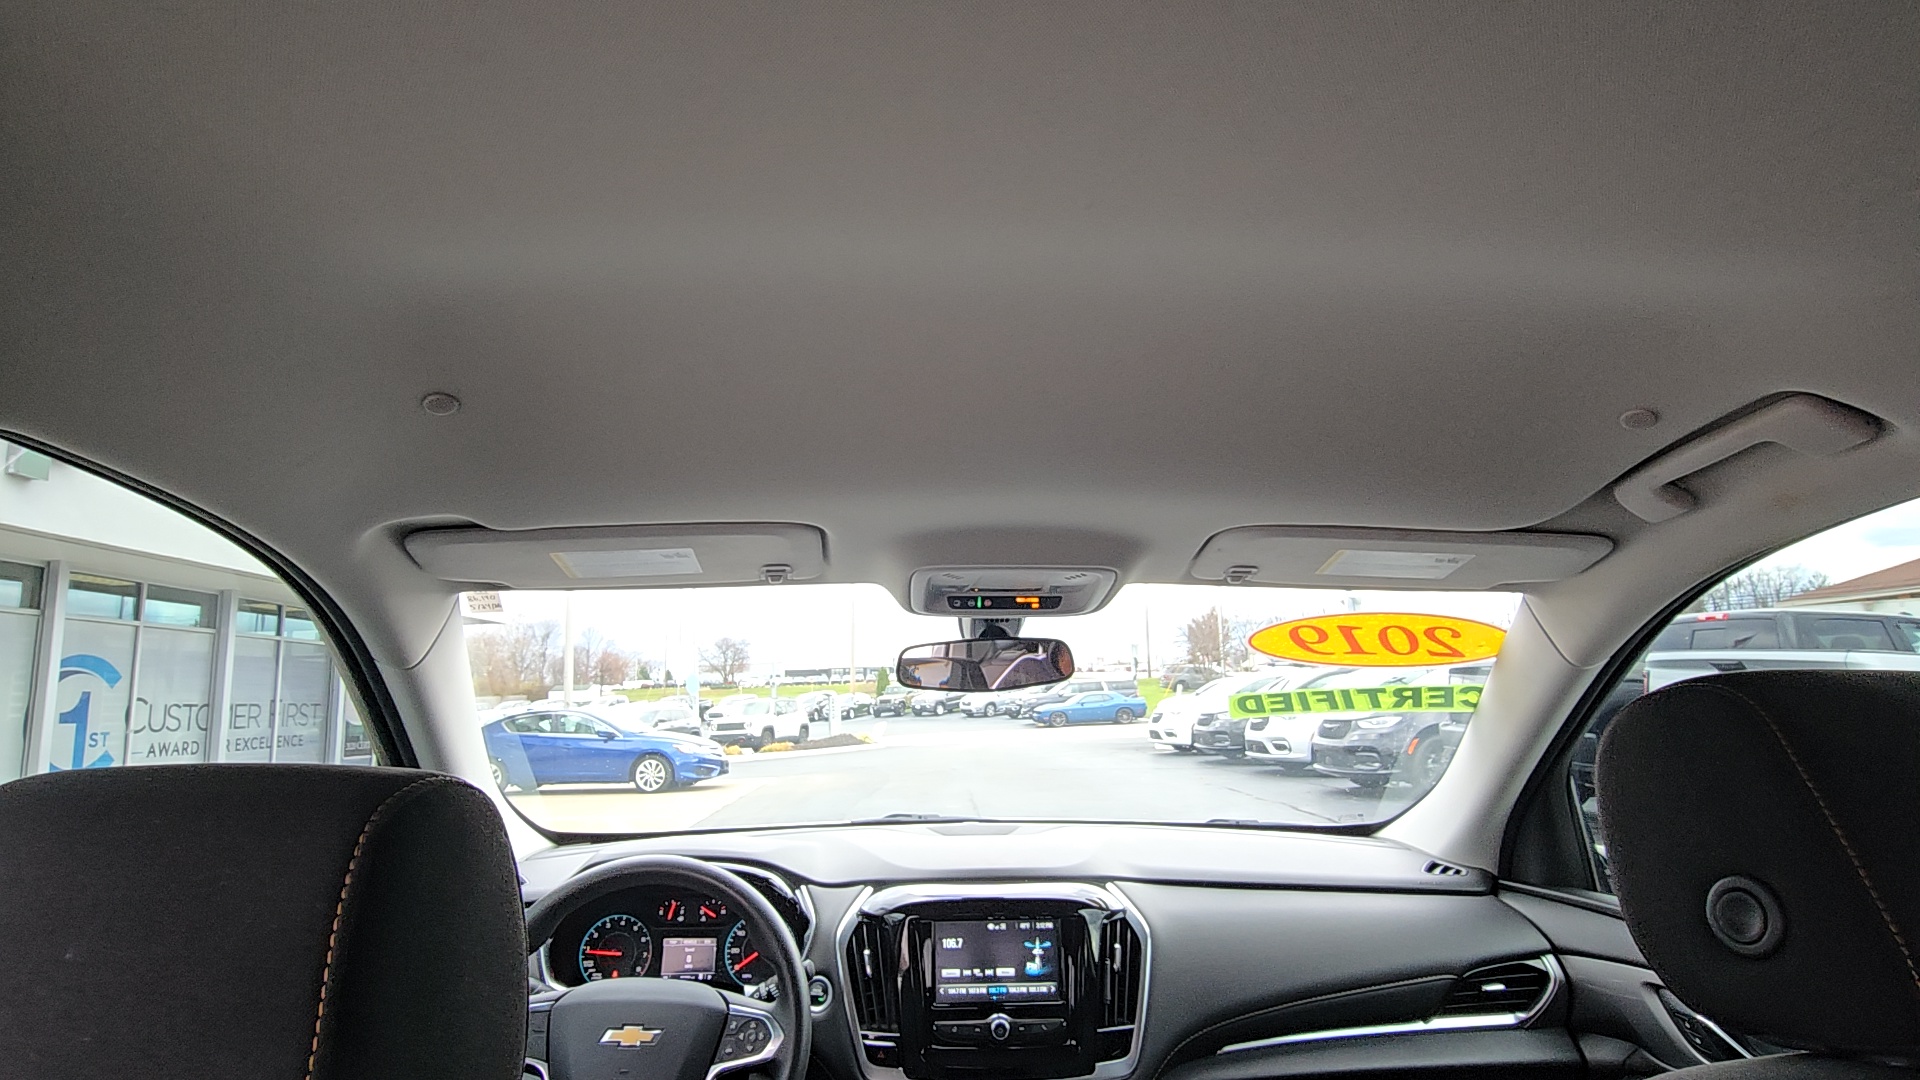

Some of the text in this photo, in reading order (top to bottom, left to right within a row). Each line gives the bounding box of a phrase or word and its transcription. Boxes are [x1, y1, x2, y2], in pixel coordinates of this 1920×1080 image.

[124, 697, 322, 734] CUSTOER FIRST
[146, 740, 200, 758] AWARD
[234, 734, 304, 752] EXCELENCE
[942, 938, 963, 949] 106.7
